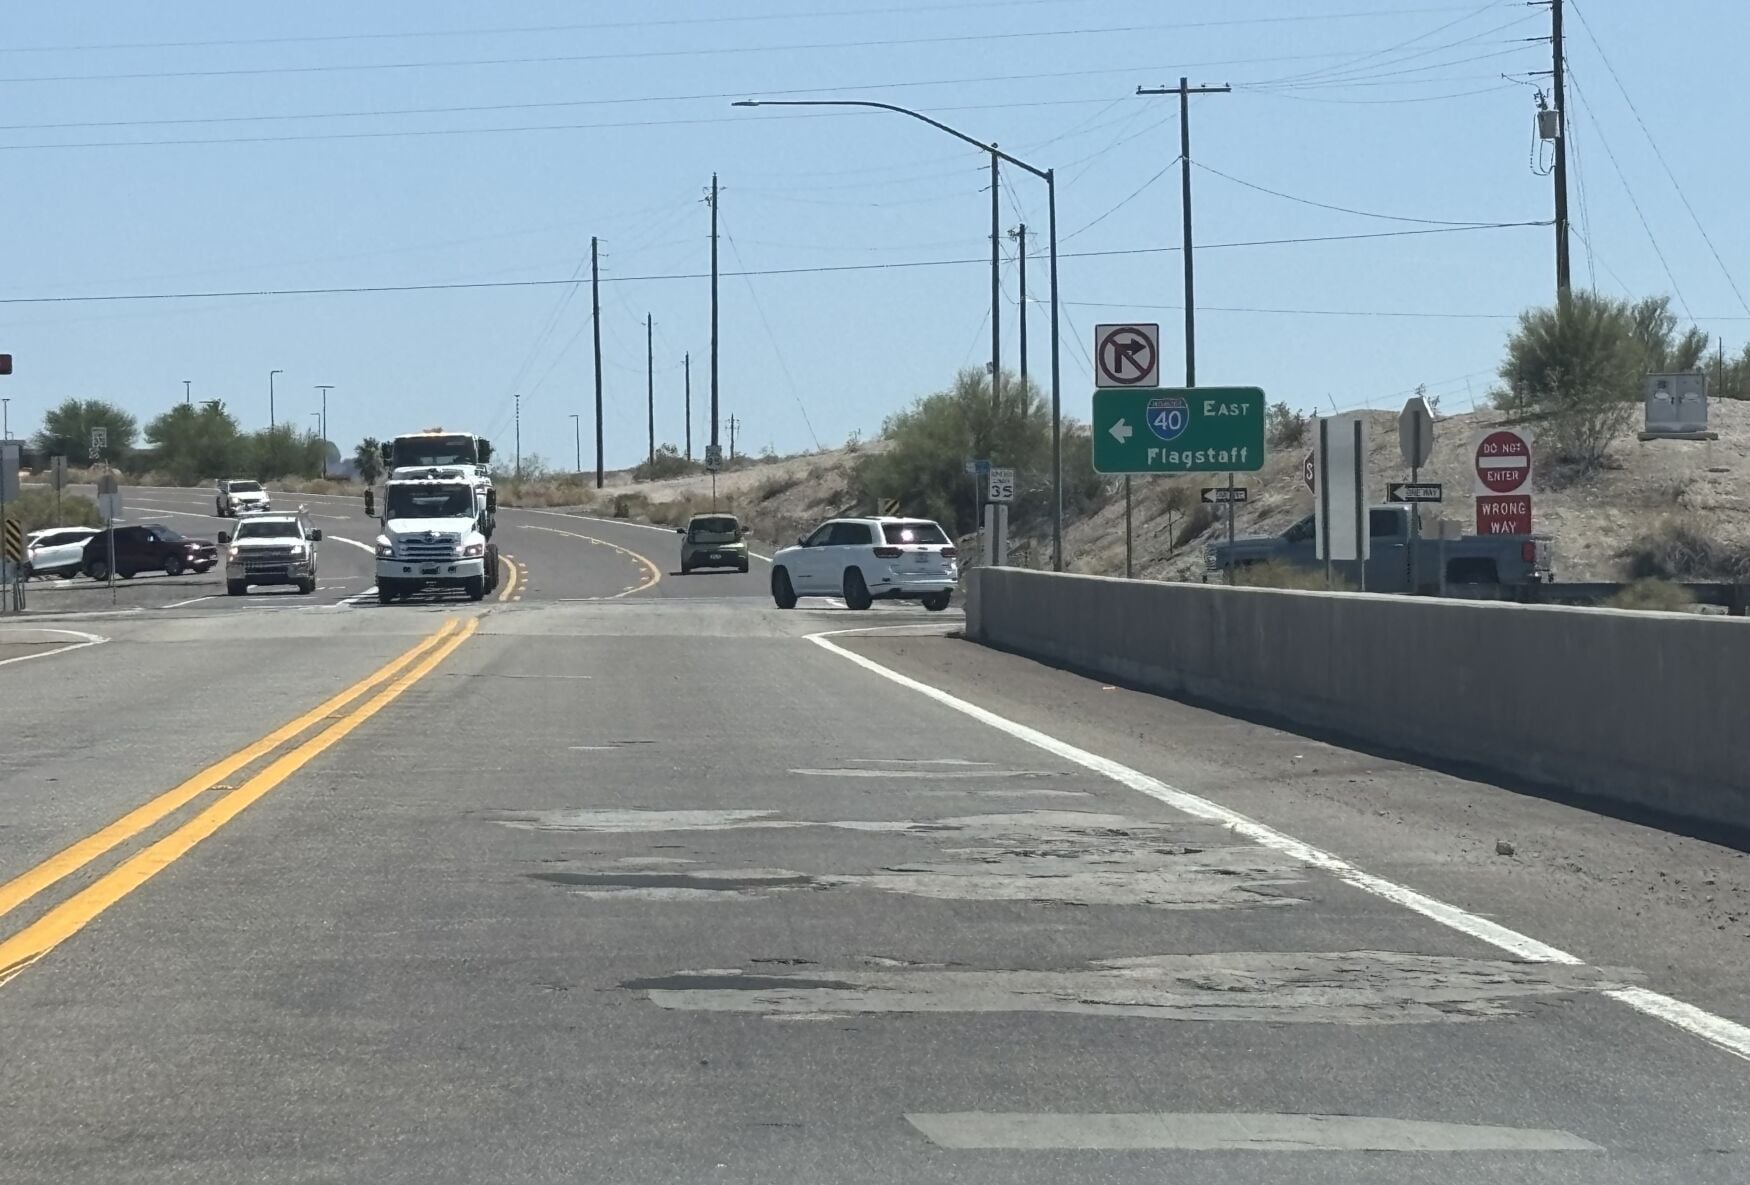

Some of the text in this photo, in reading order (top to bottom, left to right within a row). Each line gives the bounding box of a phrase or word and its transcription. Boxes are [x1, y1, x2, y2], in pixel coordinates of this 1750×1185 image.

[1153, 410, 1182, 431] 40
[1483, 443, 1521, 453] DO NOT
[1147, 447, 1248, 468] Flagstaff
[1487, 470, 1519, 481] ENTER
[991, 485, 1013, 498] 35
[1482, 502, 1526, 516] WRONG
[1490, 521, 1517, 534] WAY
